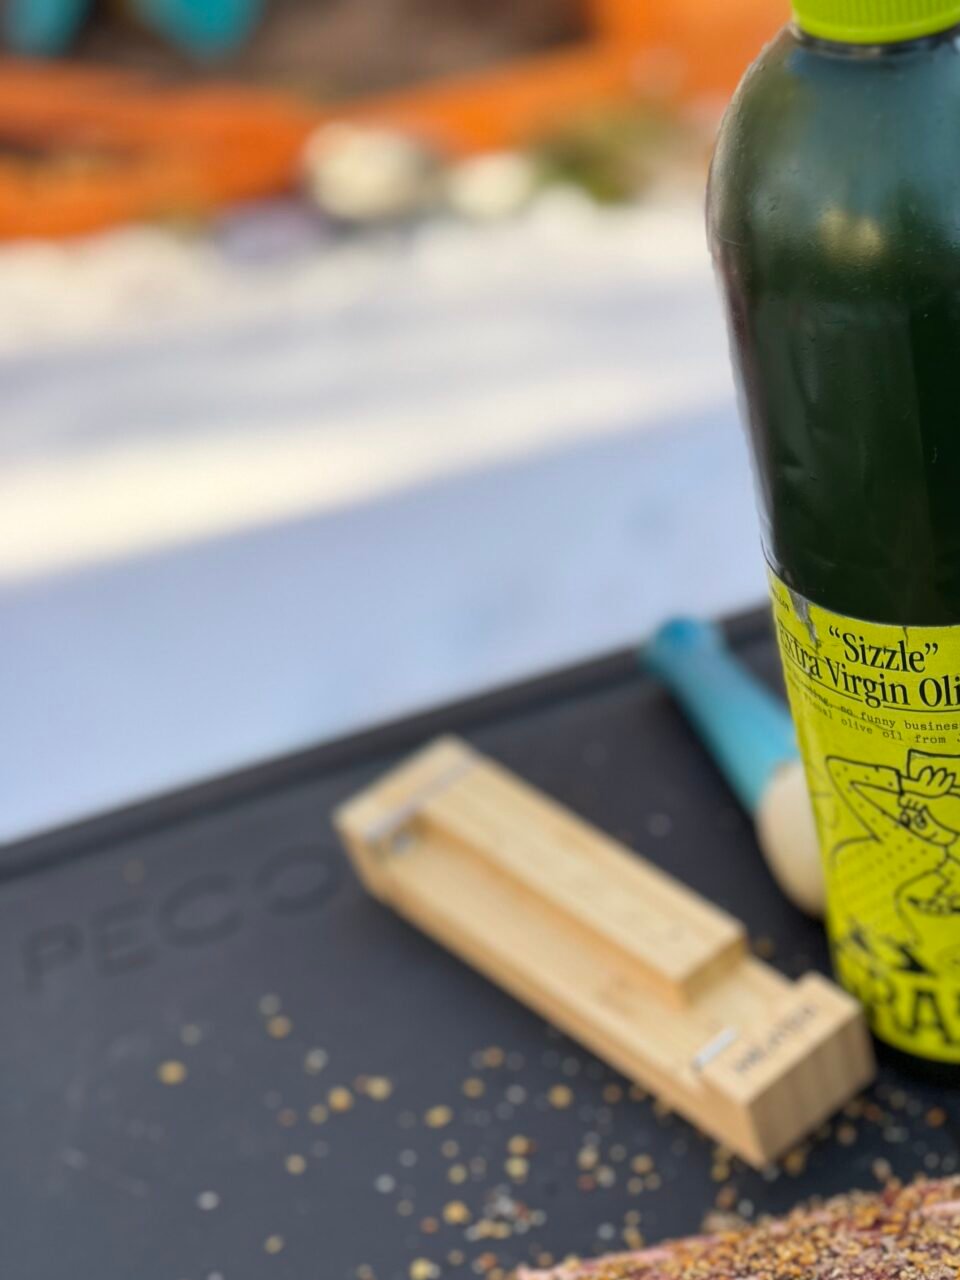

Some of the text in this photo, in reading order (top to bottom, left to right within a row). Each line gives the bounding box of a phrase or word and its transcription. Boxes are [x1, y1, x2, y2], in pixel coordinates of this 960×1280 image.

[825, 655, 911, 708] Virgin
[841, 719, 873, 734] olive
[882, 730, 902, 741] oil
[915, 733, 946, 744] from
[861, 711, 896, 728] funny
